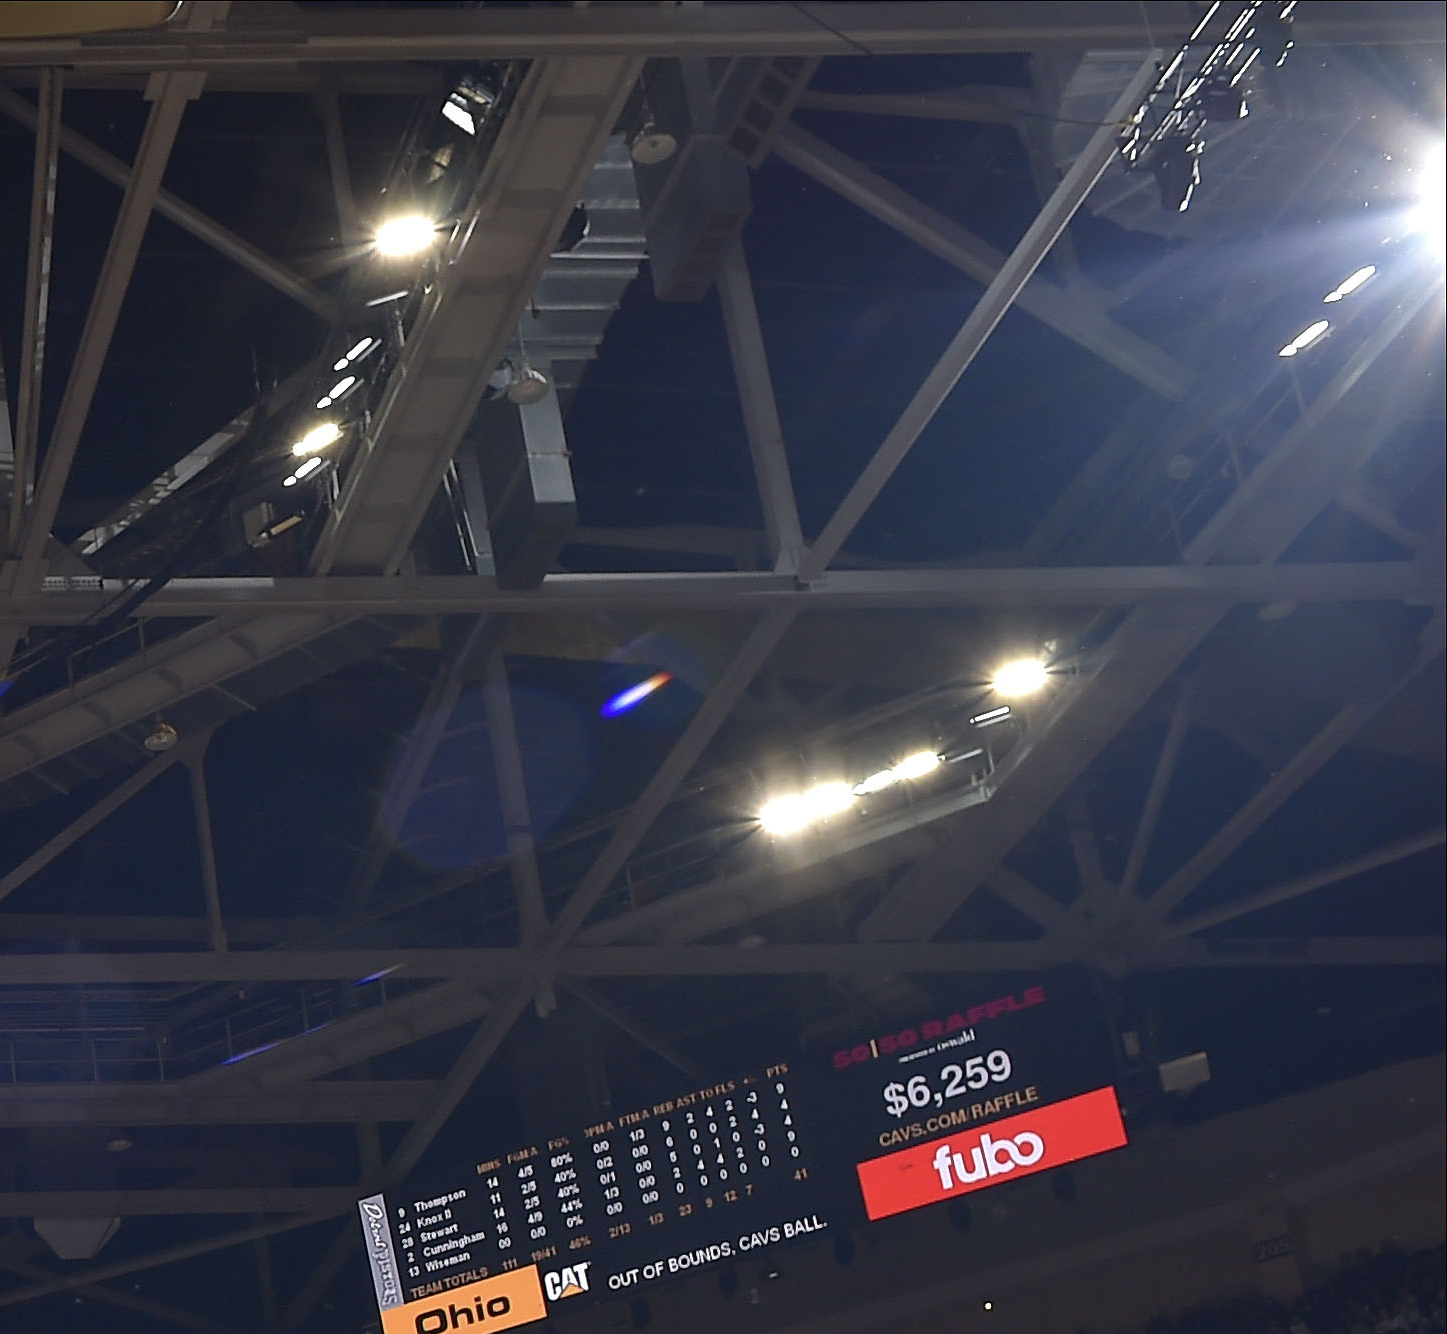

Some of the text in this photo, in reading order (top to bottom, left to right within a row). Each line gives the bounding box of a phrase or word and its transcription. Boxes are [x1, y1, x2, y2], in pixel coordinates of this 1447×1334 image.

[921, 986, 1047, 1039] RAFFLE
[883, 1049, 1012, 1118] $6,259
[878, 1086, 1039, 1147] CAVS.COM/RAFFLE
[933, 1131, 1045, 1190] fubo
[414, 1190, 467, 1213] Thompson
[398, 1223, 411, 1234] 24
[417, 1212, 444, 1228] Knox
[420, 1223, 459, 1242] Stewart
[423, 1231, 485, 1257] Cunningham
[608, 1214, 828, 1290] OUT OF BOUNDS, CAVS BALL.
[426, 1252, 471, 1272] Wiseman
[410, 1267, 489, 1299] TEAM TOTALS
[544, 1263, 590, 1300] CAT
